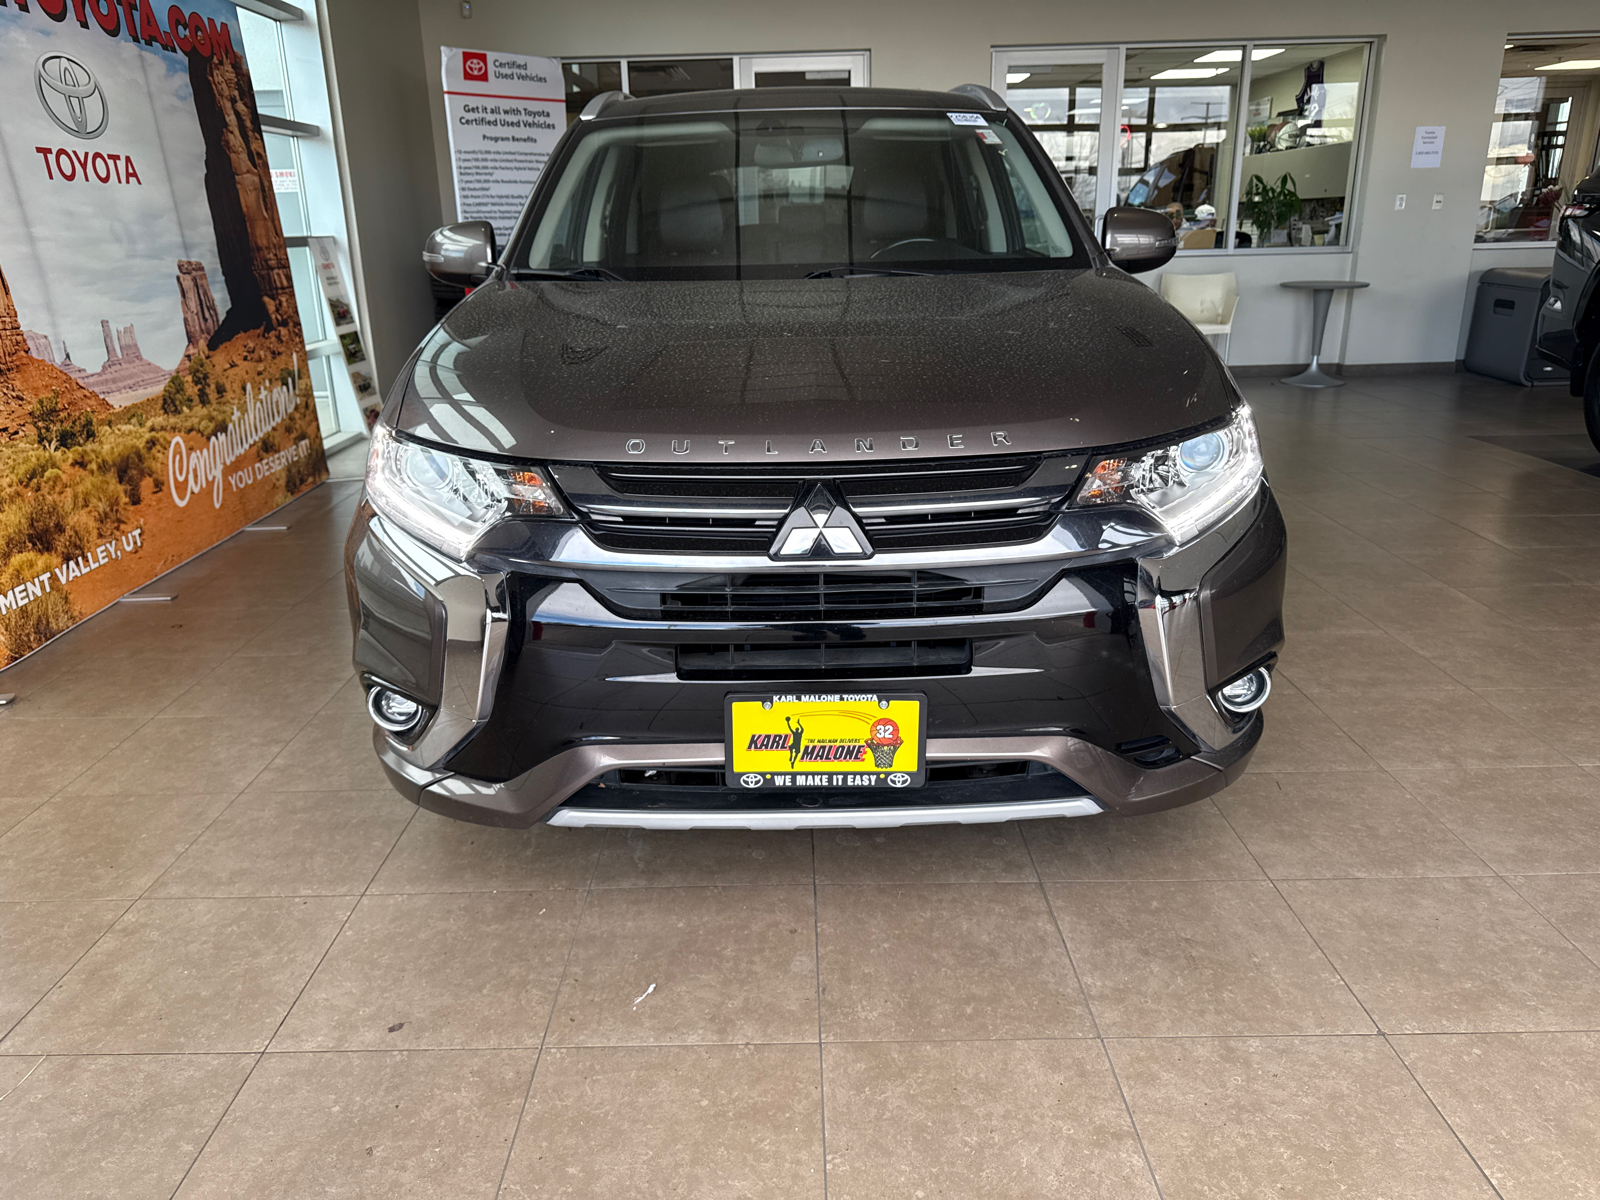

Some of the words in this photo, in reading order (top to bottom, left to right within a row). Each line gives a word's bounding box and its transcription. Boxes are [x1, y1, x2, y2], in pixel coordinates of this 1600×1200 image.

[493, 59, 528, 71] Certified
[494, 70, 515, 80] Used
[516, 72, 547, 83] Vehicles
[463, 104, 480, 114] Get
[481, 105, 488, 114] it
[490, 105, 501, 115] all
[502, 106, 522, 116] with
[523, 108, 550, 119] Toyota
[459, 116, 498, 127] Certified
[499, 118, 521, 128] Used
[522, 120, 556, 130] Vehicles
[482, 134, 511, 143] Program
[511, 135, 537, 144] Benefits
[35, 146, 142, 186] TOYOTA
[168, 352, 300, 509] Congratulations!
[625, 431, 1012, 455] OUTLANDER
[228, 465, 254, 492] YOU
[254, 444, 299, 480] DESERVE
[298, 438, 311, 458] IT!
[0, 571, 51, 616] MENT
[54, 539, 122, 585] VALLEY,
[121, 528, 142, 552] UT
[773, 695, 797, 703] KARL
[842, 694, 878, 702] TOYOTA
[876, 725, 894, 739] 32
[746, 734, 791, 751] KARL
[800, 745, 867, 762] MALONE
[774, 775, 792, 786] WE
[796, 775, 829, 786] MAKE
[832, 775, 844, 786] IT
[847, 774, 877, 786] EASY
